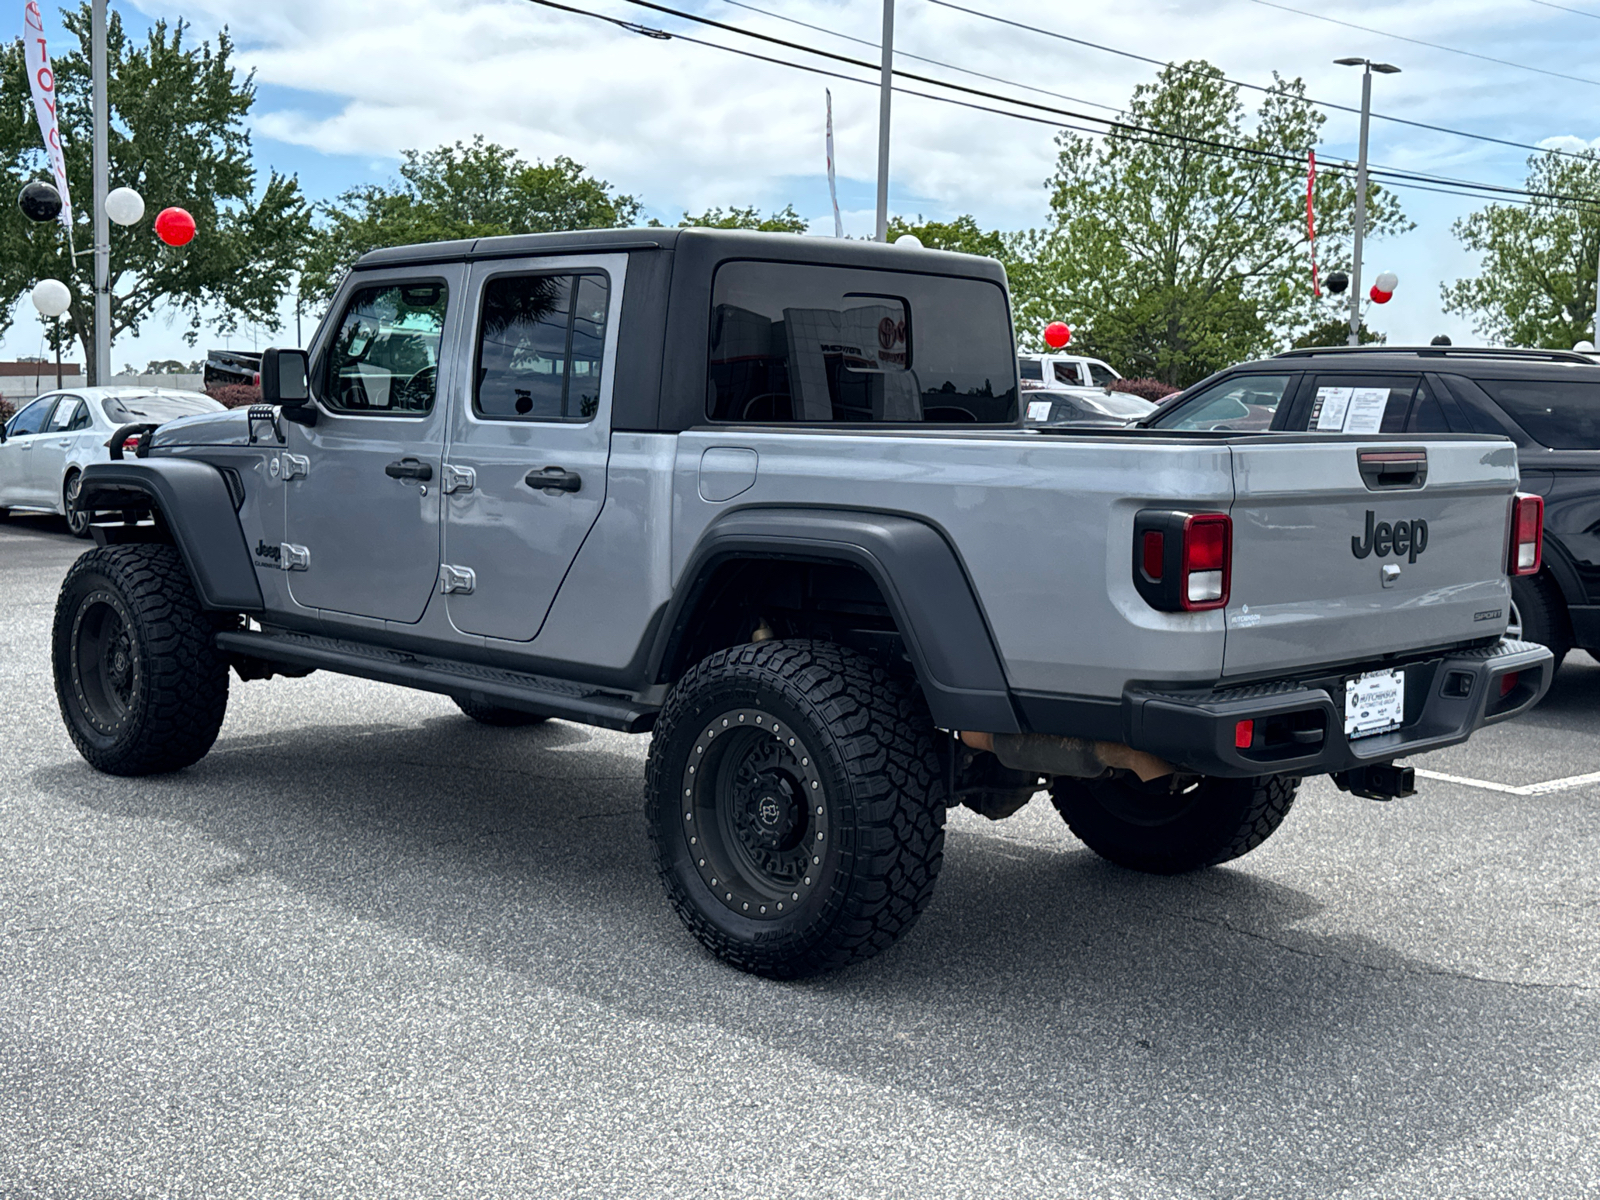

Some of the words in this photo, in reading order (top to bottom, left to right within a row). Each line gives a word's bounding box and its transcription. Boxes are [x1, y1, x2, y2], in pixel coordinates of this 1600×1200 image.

[36, 38, 70, 207] TOYO
[1351, 510, 1429, 564] Jeep
[255, 539, 281, 562] Jeep
[1474, 610, 1502, 621] SPORT
[1360, 689, 1397, 702] HUTCHINSON
